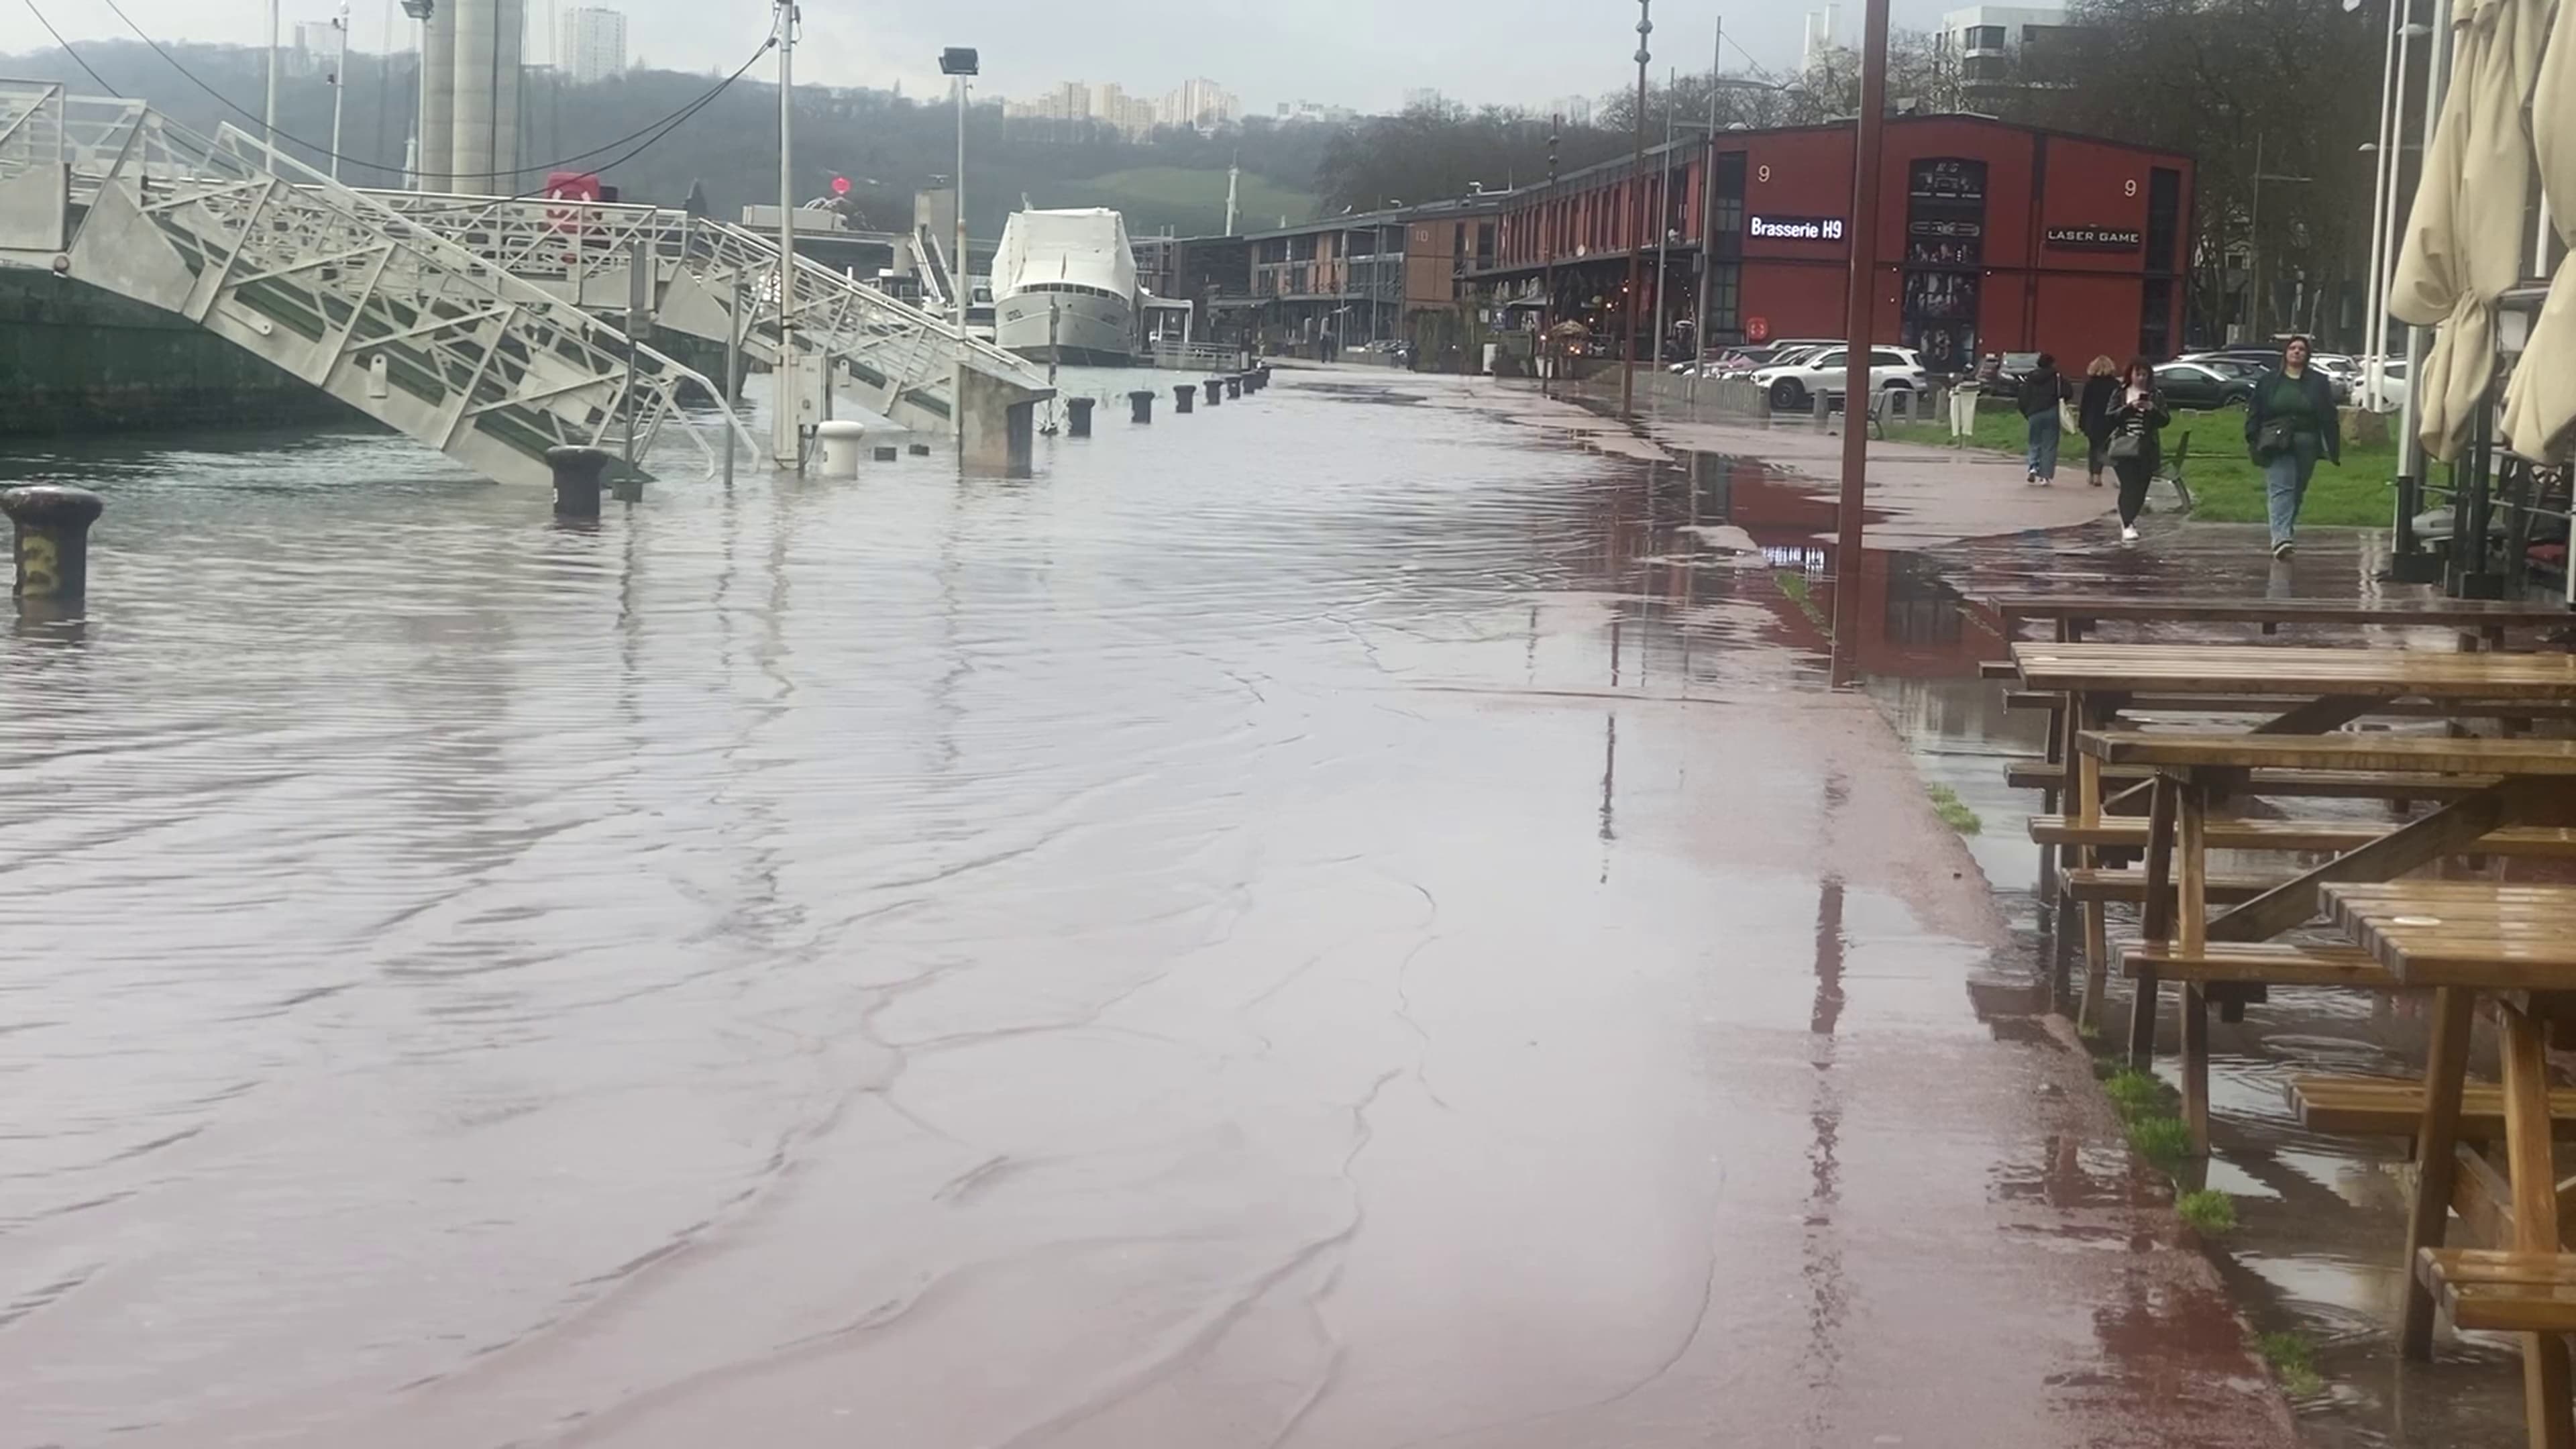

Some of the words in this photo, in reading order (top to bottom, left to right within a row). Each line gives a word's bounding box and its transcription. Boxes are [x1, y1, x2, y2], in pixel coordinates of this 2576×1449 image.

[1758, 165, 1770, 182] 9
[2124, 179, 2137, 197] 9
[1751, 217, 1819, 239] Brasserie
[1822, 219, 1842, 239] H9
[2047, 230, 2094, 241] LASER
[2098, 232, 2139, 243] GAME
